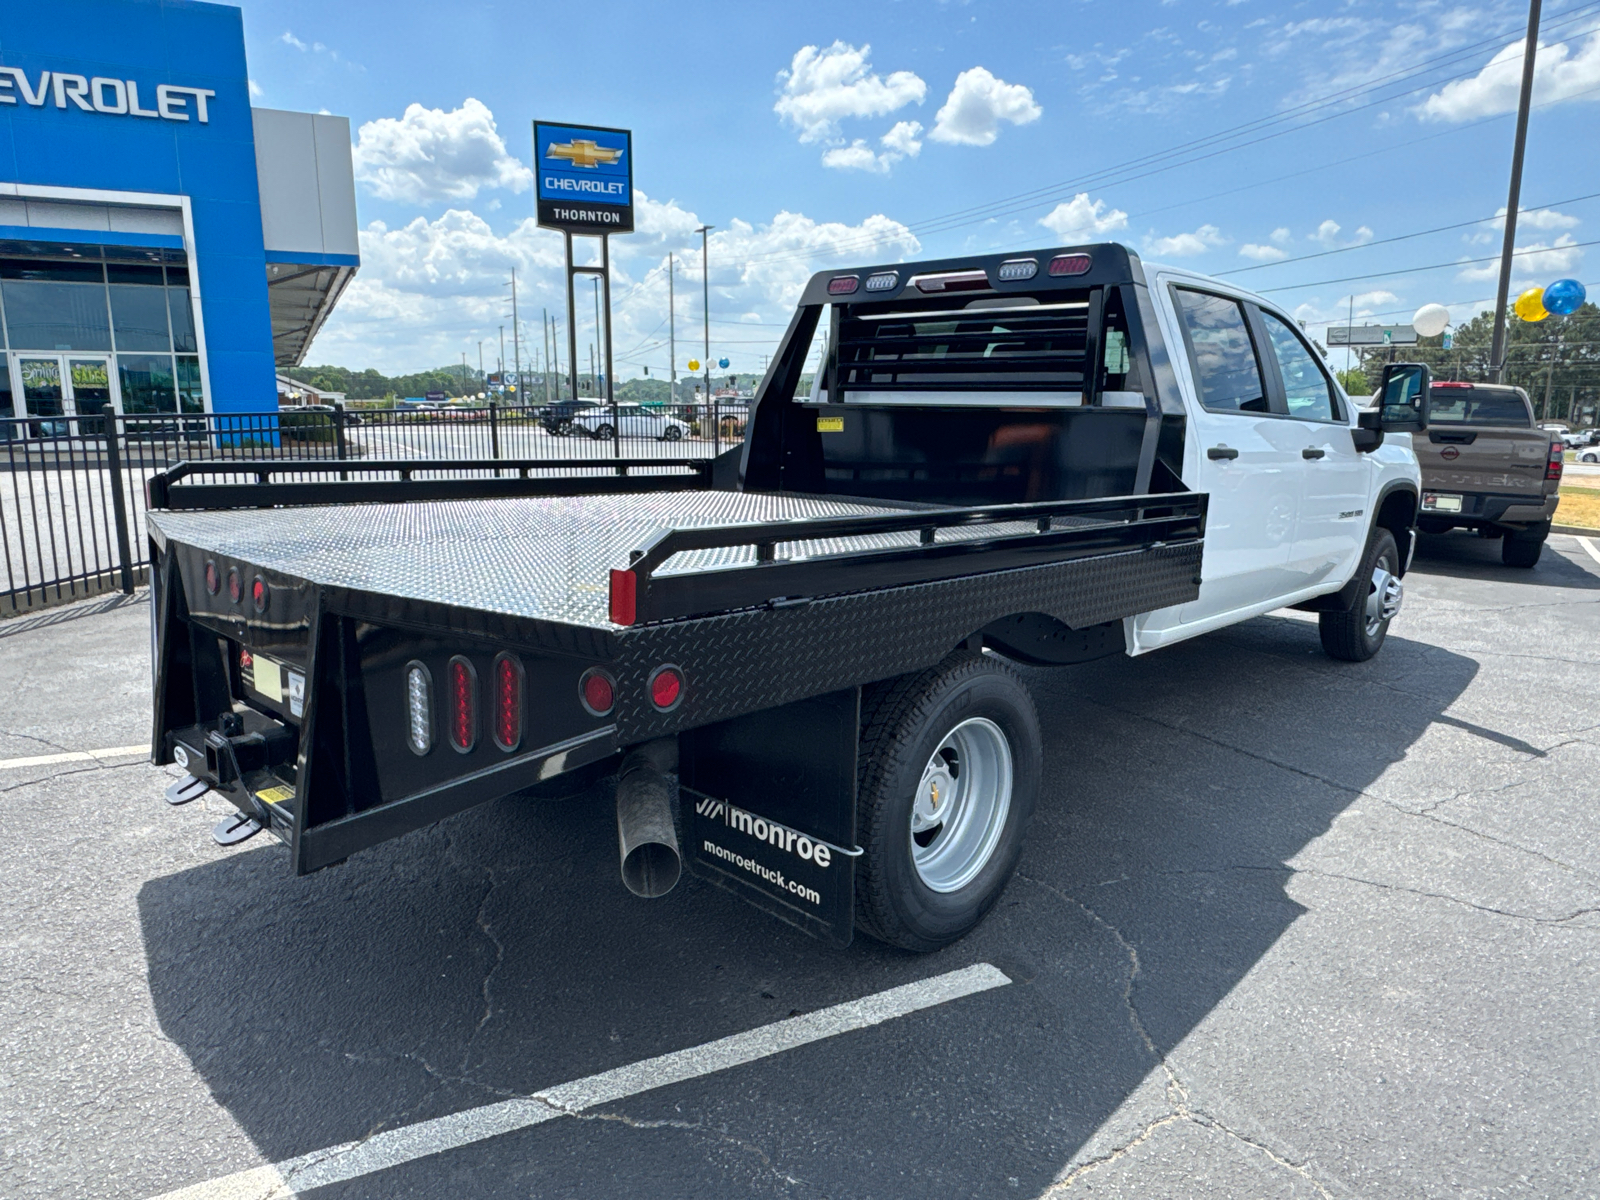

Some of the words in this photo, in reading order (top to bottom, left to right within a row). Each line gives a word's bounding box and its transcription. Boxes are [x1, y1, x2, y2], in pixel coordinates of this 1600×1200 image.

[545, 177, 625, 195] CHEVROLET
[553, 208, 620, 223] THORNTON
[730, 808, 832, 868] monroe
[703, 840, 821, 905] monroetruck.com
